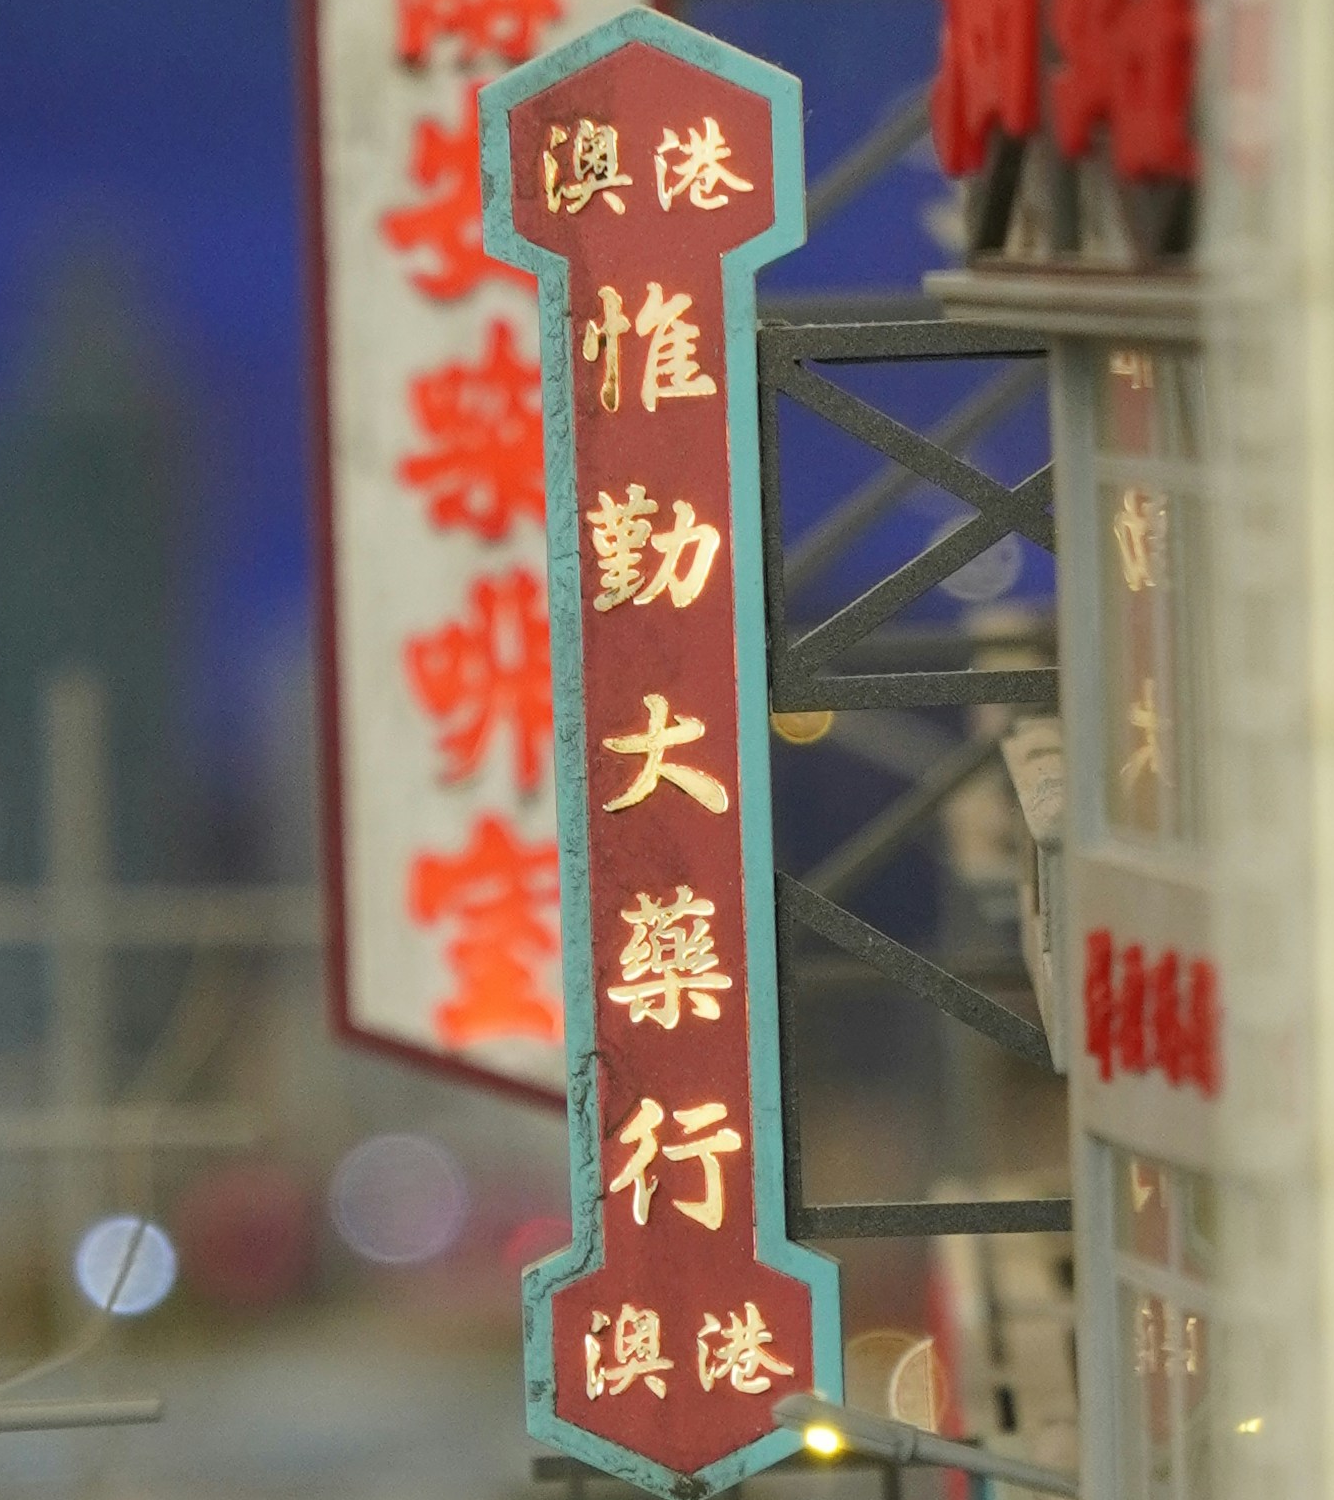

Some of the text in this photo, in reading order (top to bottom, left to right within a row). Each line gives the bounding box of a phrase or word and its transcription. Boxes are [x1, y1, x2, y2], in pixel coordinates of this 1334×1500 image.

[581, 280, 743, 1232] 惟勤大藥行
